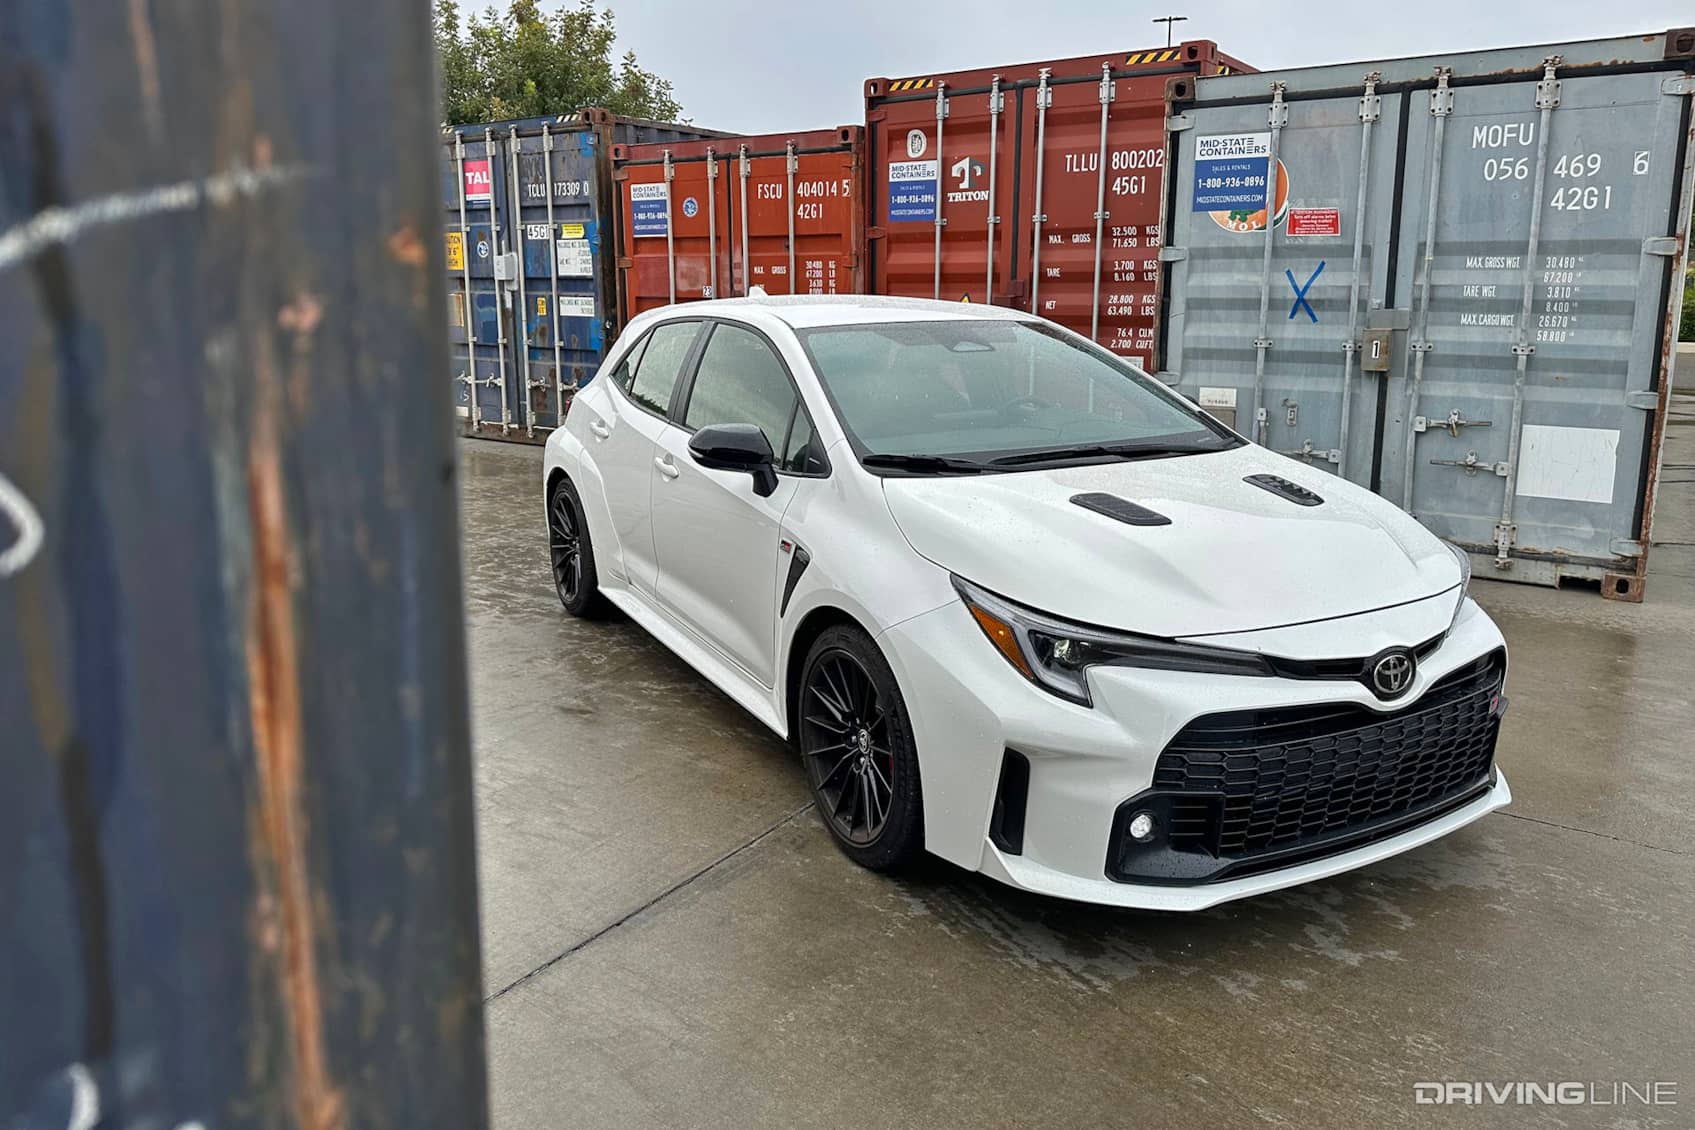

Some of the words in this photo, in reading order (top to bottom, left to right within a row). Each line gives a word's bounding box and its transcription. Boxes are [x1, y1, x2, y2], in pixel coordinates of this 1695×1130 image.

[1472, 123, 1534, 148] MOFU
[1200, 138, 1254, 148] MID-STATE
[1200, 145, 1266, 156] CONTAINERS
[1065, 153, 1098, 172] TLLU
[1112, 149, 1163, 170] 800202
[1484, 158, 1529, 180] 056
[1553, 154, 1601, 178] 469
[1634, 152, 1650, 175] 6
[465, 171, 490, 185] TAL
[892, 170, 935, 178] CONTAINERS
[1112, 176, 1146, 195] 45G1
[1198, 176, 1264, 188] 1-800-936-0896
[528, 184, 546, 197] TCLU
[554, 182, 580, 196] 173309
[758, 184, 782, 199] FSCU
[797, 181, 837, 198] 404014
[842, 179, 850, 197] 5
[948, 190, 989, 202] TRITON
[1550, 186, 1612, 210] 42G1
[797, 204, 822, 218] 42G1
[1112, 227, 1137, 236] 32.500
[1146, 225, 1160, 235] KGS
[1226, 220, 1262, 231] MOL
[1072, 234, 1091, 244] GROSS
[1112, 238, 1137, 248] 71.650
[1146, 236, 1160, 247] LBS
[1144, 260, 1158, 270] KGS
[1484, 256, 1505, 268] GROSS
[1046, 268, 1060, 277] TARE
[1144, 271, 1158, 280] LBS
[1464, 286, 1480, 297] TARE
[1547, 286, 1570, 298] 3.810
[1142, 294, 1156, 304] KGS
[1046, 300, 1056, 310] NET
[1140, 306, 1155, 316] LBS
[1117, 328, 1132, 337] 76.4
[1110, 340, 1132, 348] 2.700
